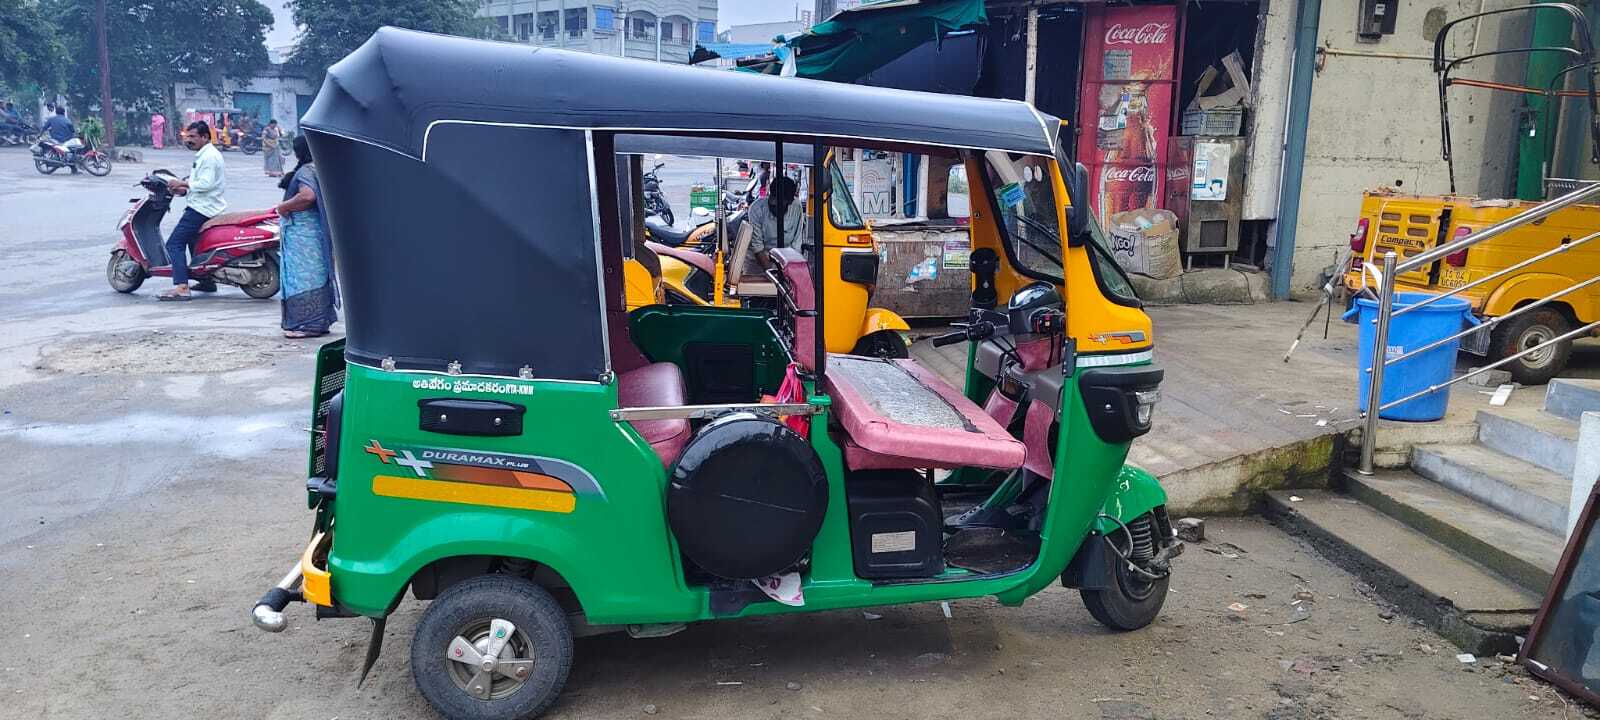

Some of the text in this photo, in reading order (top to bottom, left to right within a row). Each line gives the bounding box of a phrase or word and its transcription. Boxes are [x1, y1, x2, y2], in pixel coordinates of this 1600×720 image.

[1105, 23, 1169, 45] Coca-Cola
[1105, 166, 1156, 182] Coca-Cola
[421, 450, 506, 466] DURAMAX
